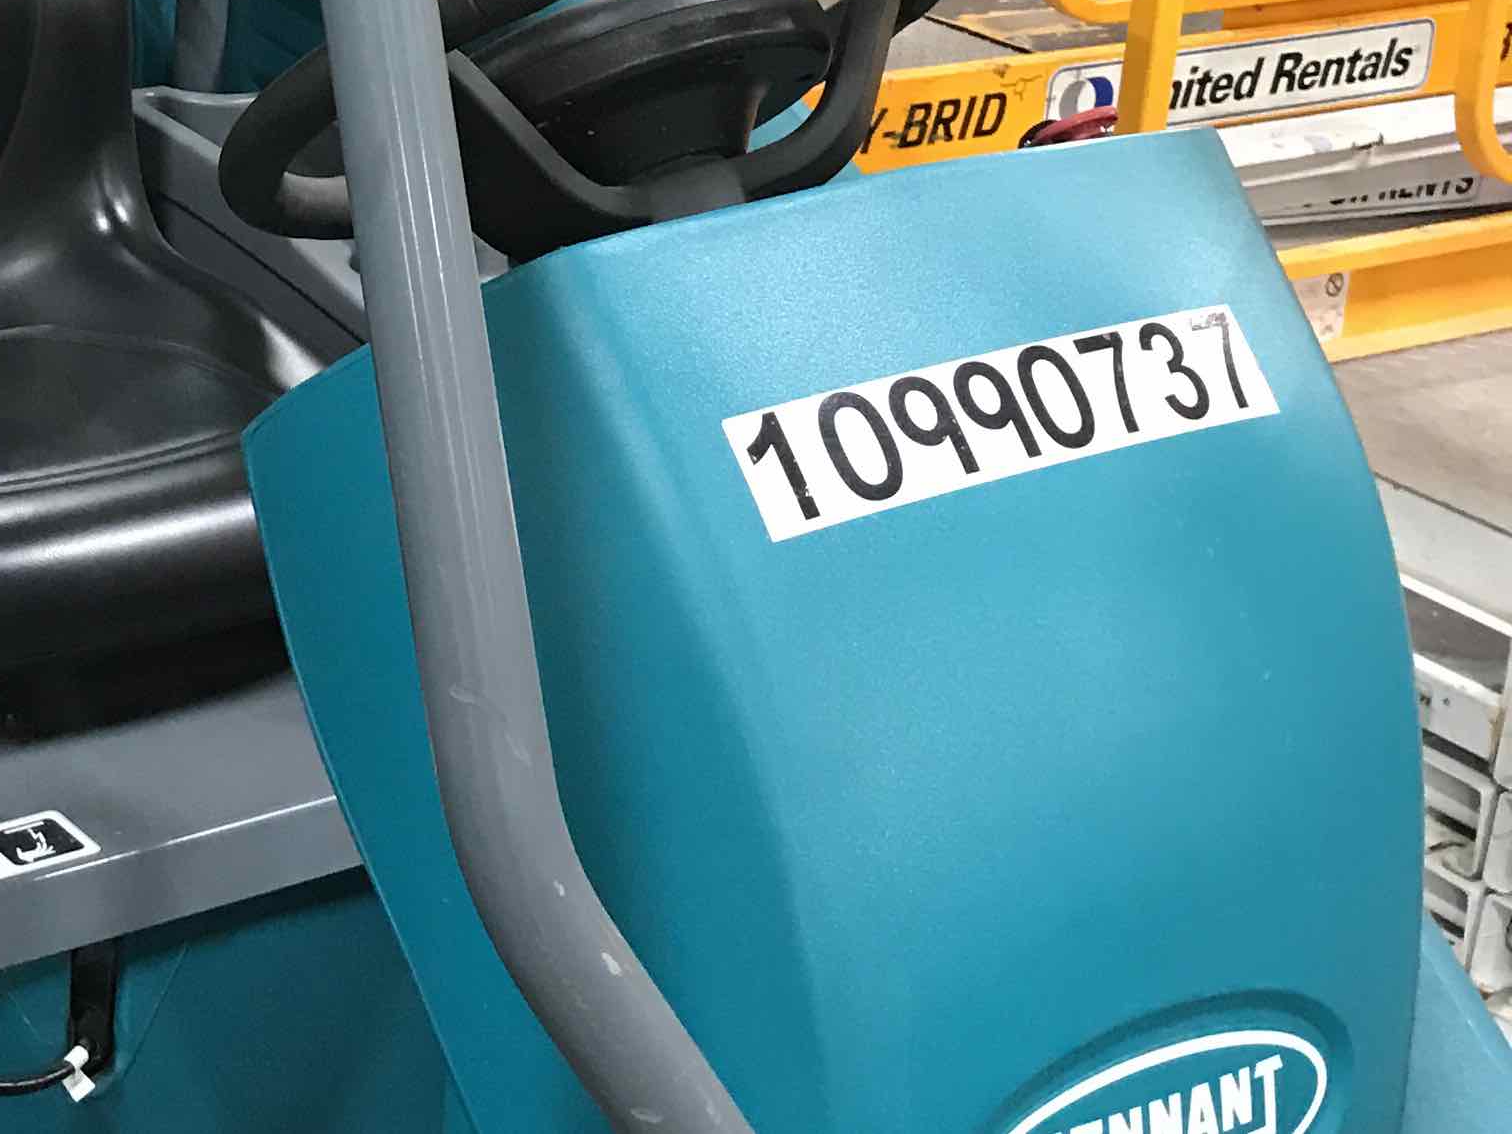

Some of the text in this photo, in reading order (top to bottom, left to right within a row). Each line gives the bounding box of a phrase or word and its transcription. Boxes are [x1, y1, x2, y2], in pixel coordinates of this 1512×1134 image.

[1168, 37, 1414, 111] nited Rentals
[859, 90, 1007, 156] Y-BRID
[746, 312, 1249, 520] 10990737
